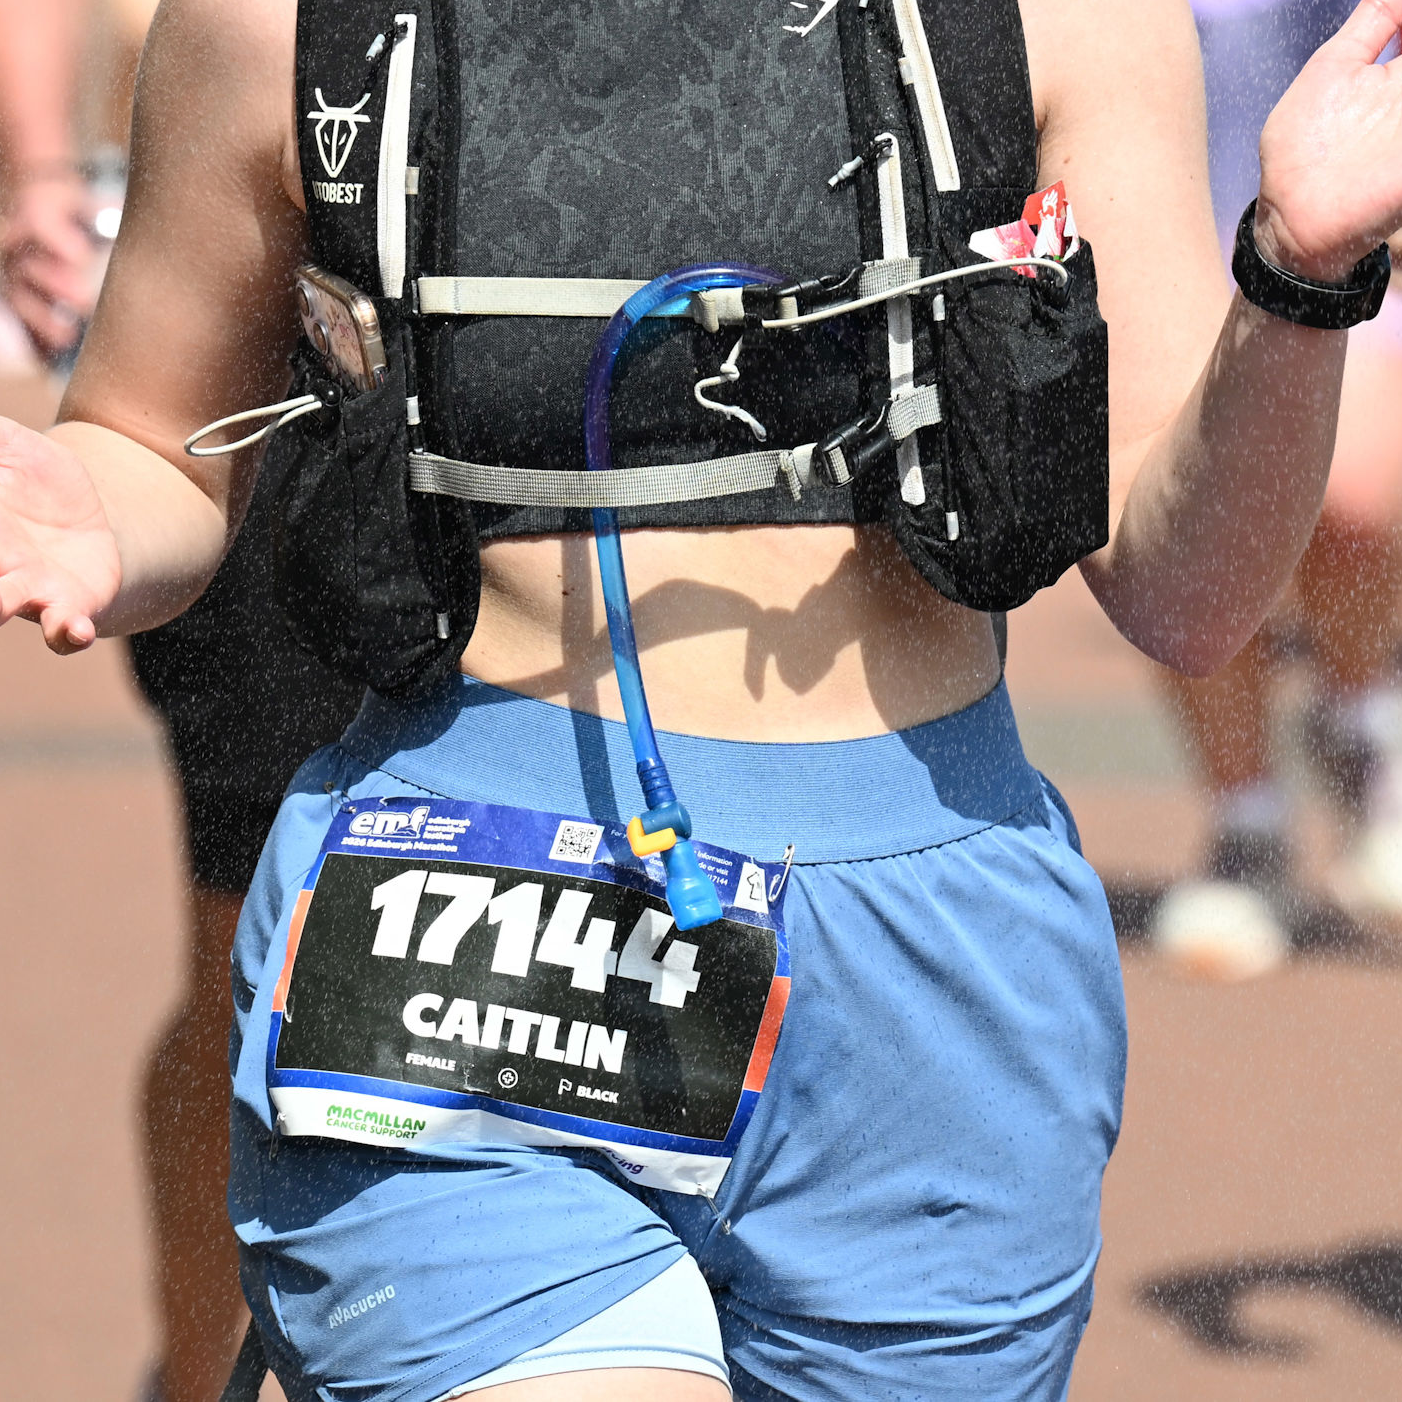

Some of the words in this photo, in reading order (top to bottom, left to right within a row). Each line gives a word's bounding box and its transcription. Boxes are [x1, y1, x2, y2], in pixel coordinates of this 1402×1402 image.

[349, 806, 430, 838] emf
[341, 837, 366, 847] 2026
[367, 839, 413, 851] Edinburgh
[413, 841, 458, 852] Marathon
[716, 867, 729, 876] visit
[371, 869, 701, 1008] 17144
[402, 992, 628, 1074] CAITLIN
[405, 1052, 457, 1072] FEMALE
[576, 1085, 620, 1104] BLACK
[326, 1104, 426, 1131] MACMILLAN
[326, 1118, 367, 1132] CANCER
[370, 1125, 418, 1139] SUPPORT
[328, 1284, 396, 1329] AYACUCHO
